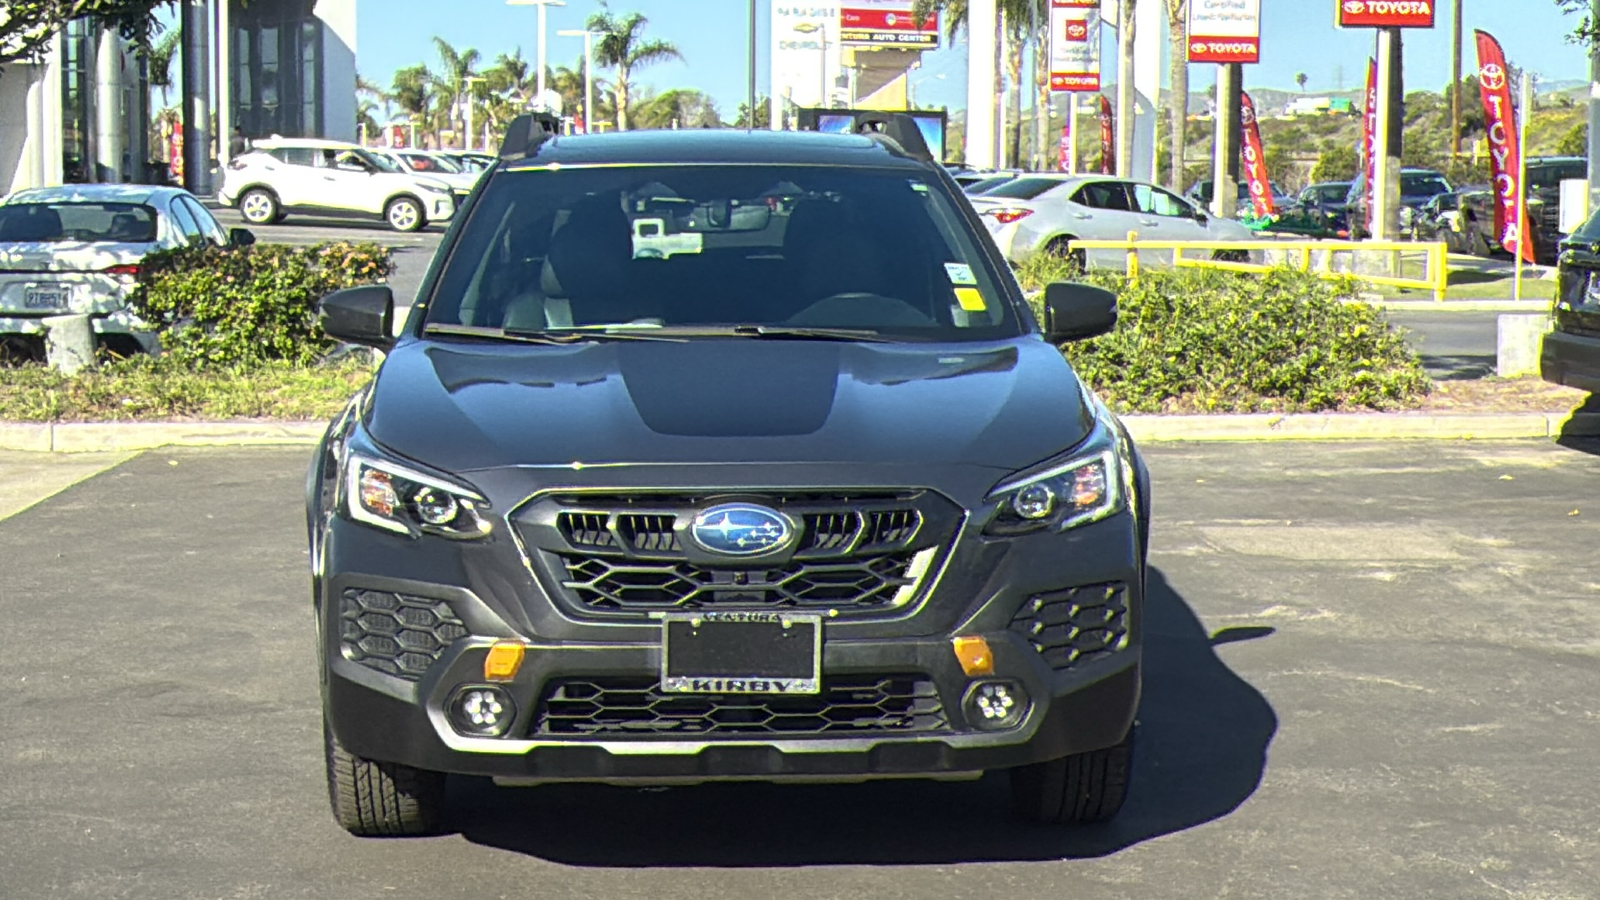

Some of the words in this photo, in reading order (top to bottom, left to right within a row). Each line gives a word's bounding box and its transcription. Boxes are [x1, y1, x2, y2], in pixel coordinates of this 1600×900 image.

[1366, 1, 1430, 14] TOYOTA
[1207, 43, 1257, 53] TOYOTA
[1064, 77, 1098, 86] TOYOTA
[1243, 128, 1267, 212] TOYOT
[692, 680, 791, 692] KIRBY
